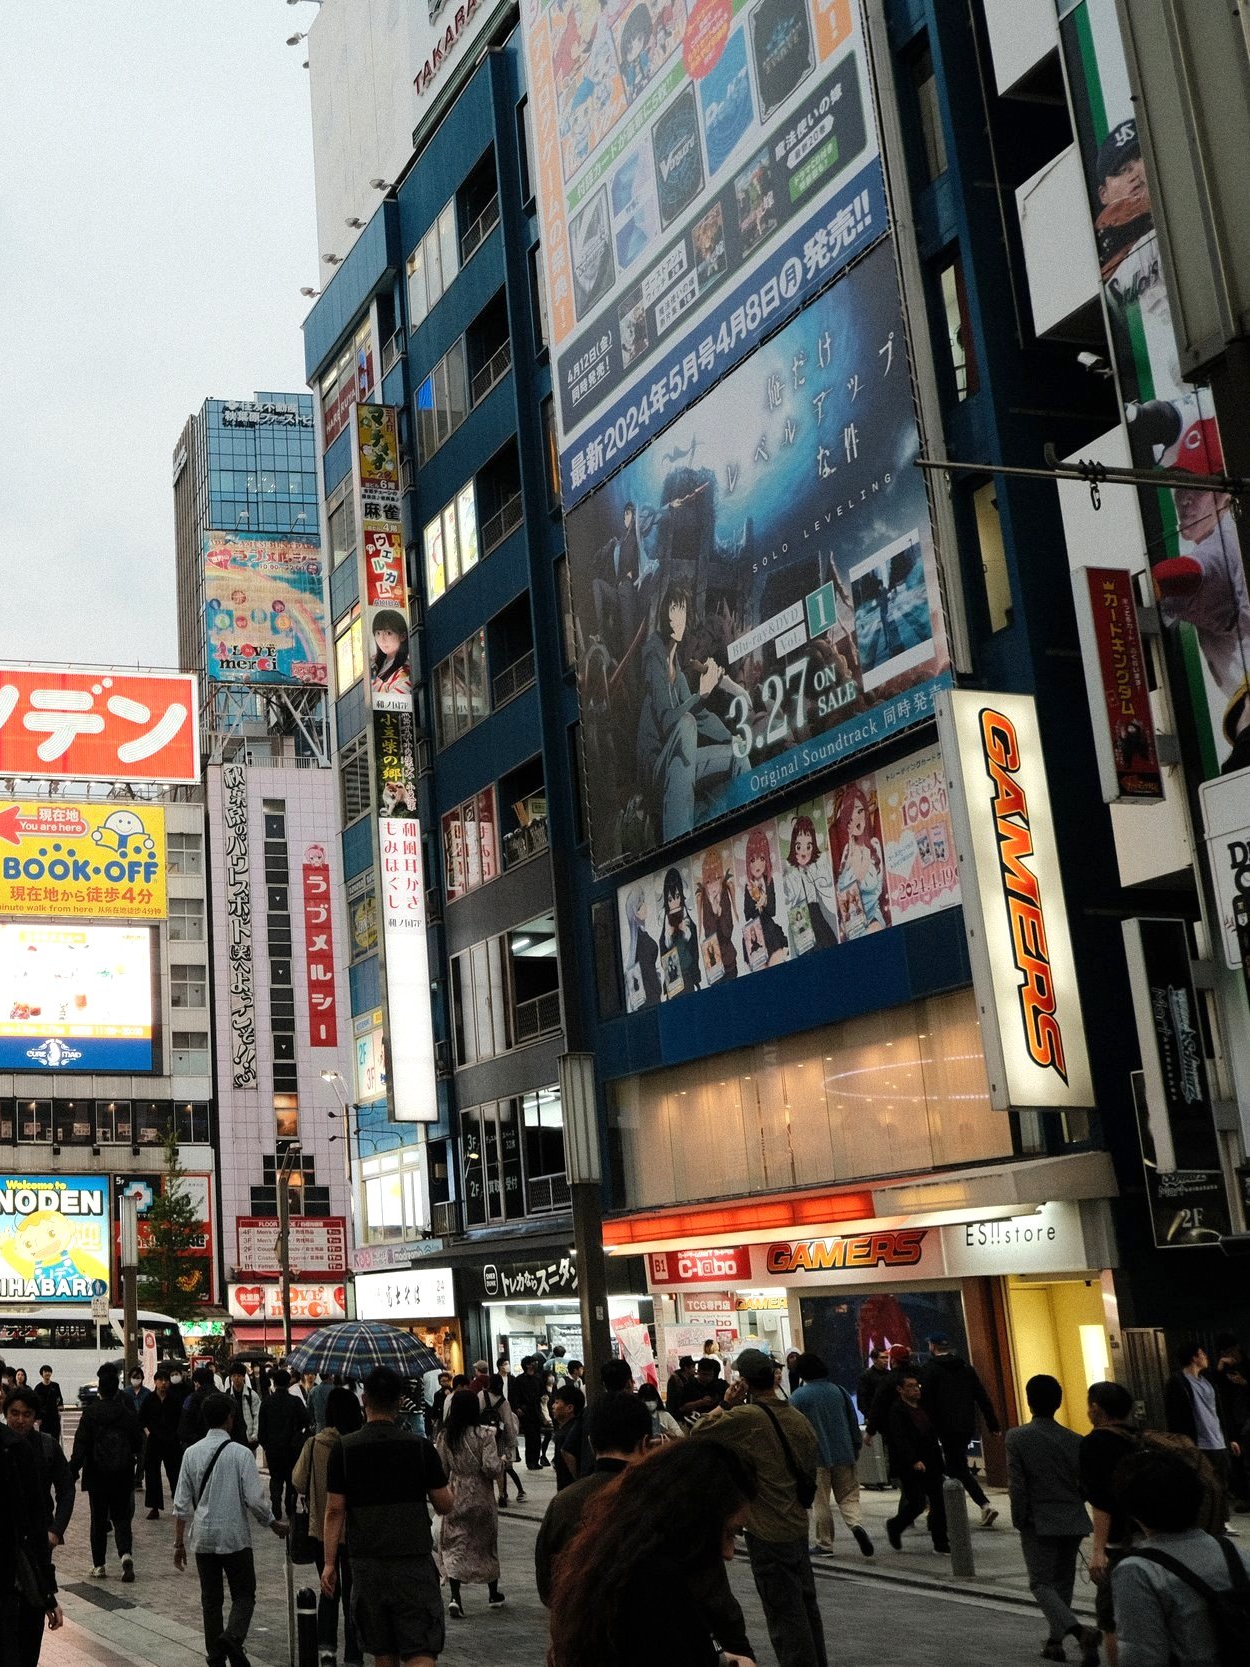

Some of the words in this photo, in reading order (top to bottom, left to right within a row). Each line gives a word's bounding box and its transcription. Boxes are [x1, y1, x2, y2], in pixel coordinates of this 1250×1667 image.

[364, 503, 400, 521] 麻雀
[752, 543, 790, 574] SOLO
[1104, 592, 1136, 716] カードキングダム
[814, 664, 837, 692] ON
[724, 656, 812, 759] 3.27
[817, 680, 857, 717] SALE
[750, 759, 800, 791] Original
[801, 720, 879, 773] Soundtrack
[19, 821, 38, 832] You
[39, 823, 57, 832] are
[58, 822, 83, 833] here
[38, 807, 79, 822] 現在地
[9, 886, 153, 904] 現在地から徒歩4分
[26, 902, 47, 912] walk
[48, 903, 68, 912] from
[69, 903, 94, 914] here
[978, 707, 1070, 1088] GAMERS
[306, 875, 333, 1040] ラブメルシー
[6, 1180, 53, 1190] Welcome
[54, 1181, 67, 1190] to
[1181, 1207, 1205, 1229] 2F
[654, 1260, 667, 1273] B1
[766, 1230, 929, 1275] GAMERS
